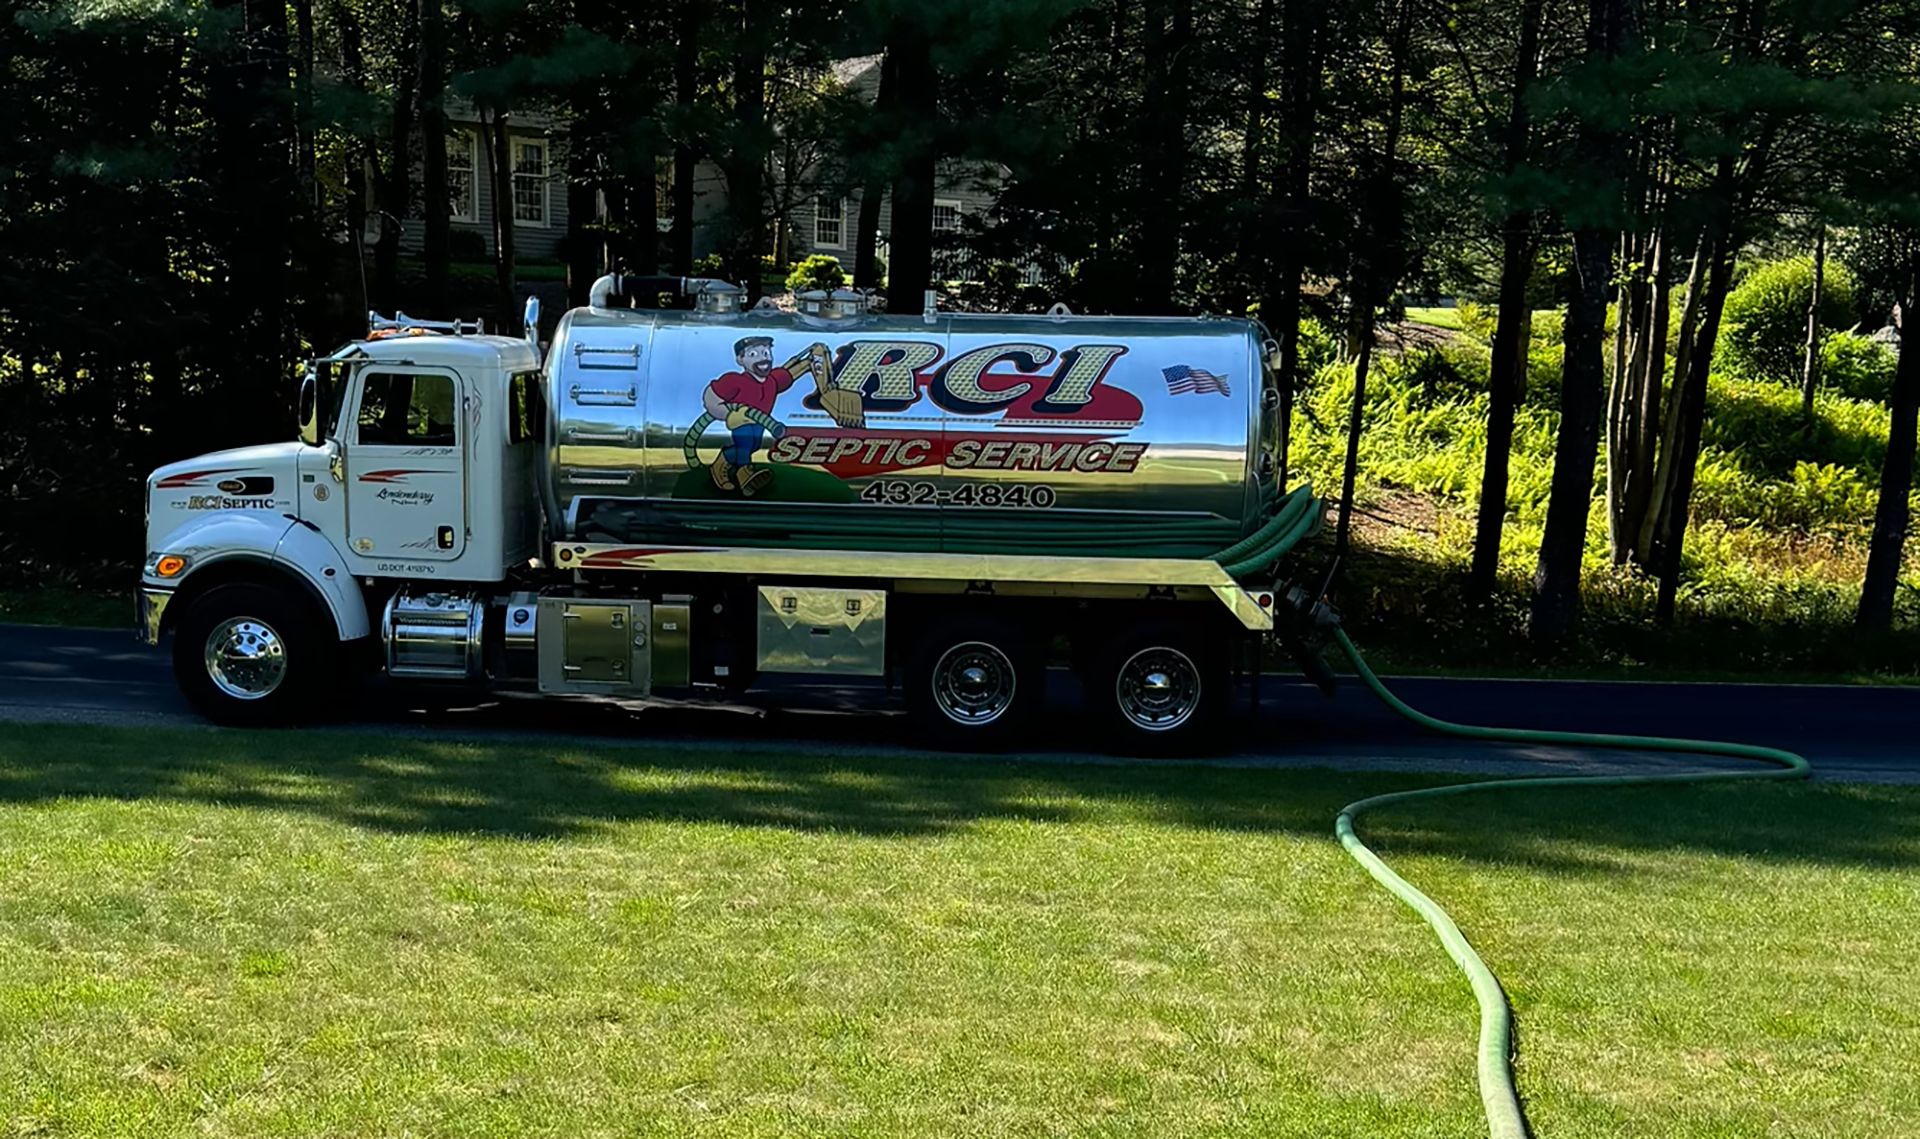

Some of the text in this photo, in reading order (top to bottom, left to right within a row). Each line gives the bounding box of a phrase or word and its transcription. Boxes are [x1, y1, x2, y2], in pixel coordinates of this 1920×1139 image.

[834, 340, 1129, 410] RCI
[770, 436, 1148, 473] SEPTIC SERVICE
[861, 480, 1056, 508] 432-4840
